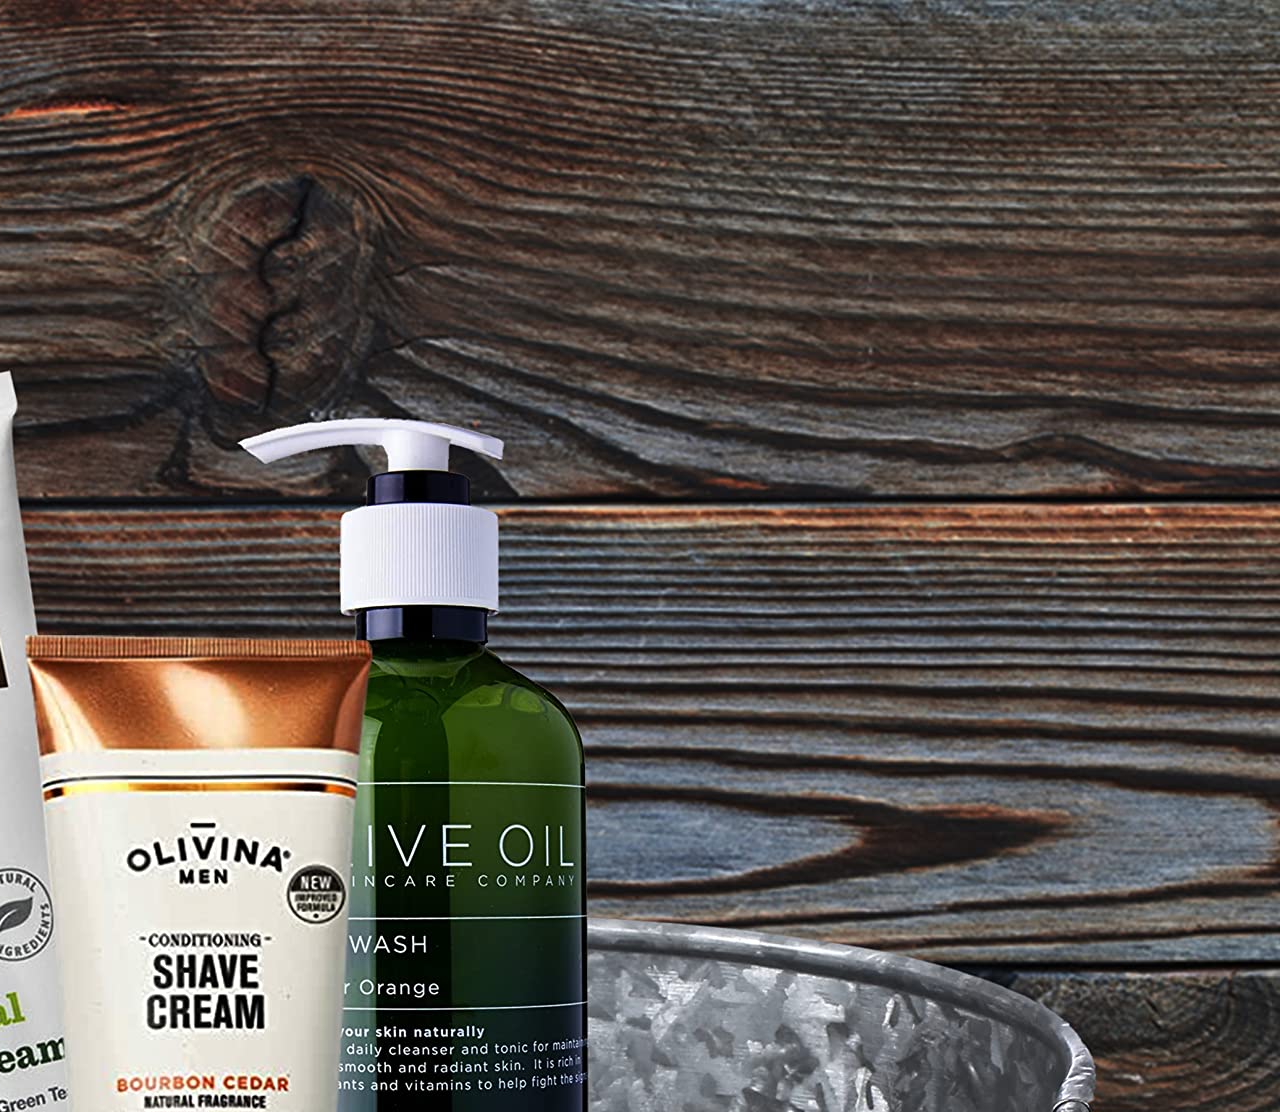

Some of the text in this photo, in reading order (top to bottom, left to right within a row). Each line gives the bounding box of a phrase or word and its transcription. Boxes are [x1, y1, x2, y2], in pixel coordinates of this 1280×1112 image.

[127, 836, 283, 872] OLIVINA
[351, 824, 574, 868] IVE OIL
[179, 869, 228, 884] MEN
[301, 875, 332, 890] NEW
[352, 875, 574, 888] INCARE COMPANY
[348, 935, 426, 953] WASH
[153, 954, 259, 989] SHAVE
[360, 979, 439, 998] Orange
[147, 994, 265, 1030] CREAM
[375, 1026, 407, 1038] skin
[414, 1025, 485, 1039] naturally
[346, 1043, 382, 1058] daily
[388, 1044, 455, 1056] cleanser
[461, 1043, 488, 1056] and
[494, 1042, 528, 1053] tonic
[533, 1040, 549, 1052] for
[338, 1061, 392, 1073] smooth
[398, 1062, 427, 1073] and
[434, 1061, 488, 1073] radiant
[494, 1060, 525, 1072] skin.
[534, 1058, 542, 1070] It
[546, 1057, 555, 1069] is
[557, 1055, 574, 1067] rich
[117, 1075, 289, 1092] BOURBON CEDAR
[370, 1080, 398, 1091] and
[405, 1079, 472, 1091] vitamins
[478, 1079, 493, 1090] to
[498, 1077, 527, 1090] help
[531, 1075, 557, 1089] fight
[560, 1073, 573, 1085] the
[47, 1086, 68, 1102] Te
[144, 1094, 267, 1109] NATURAL FRAGRANCE
